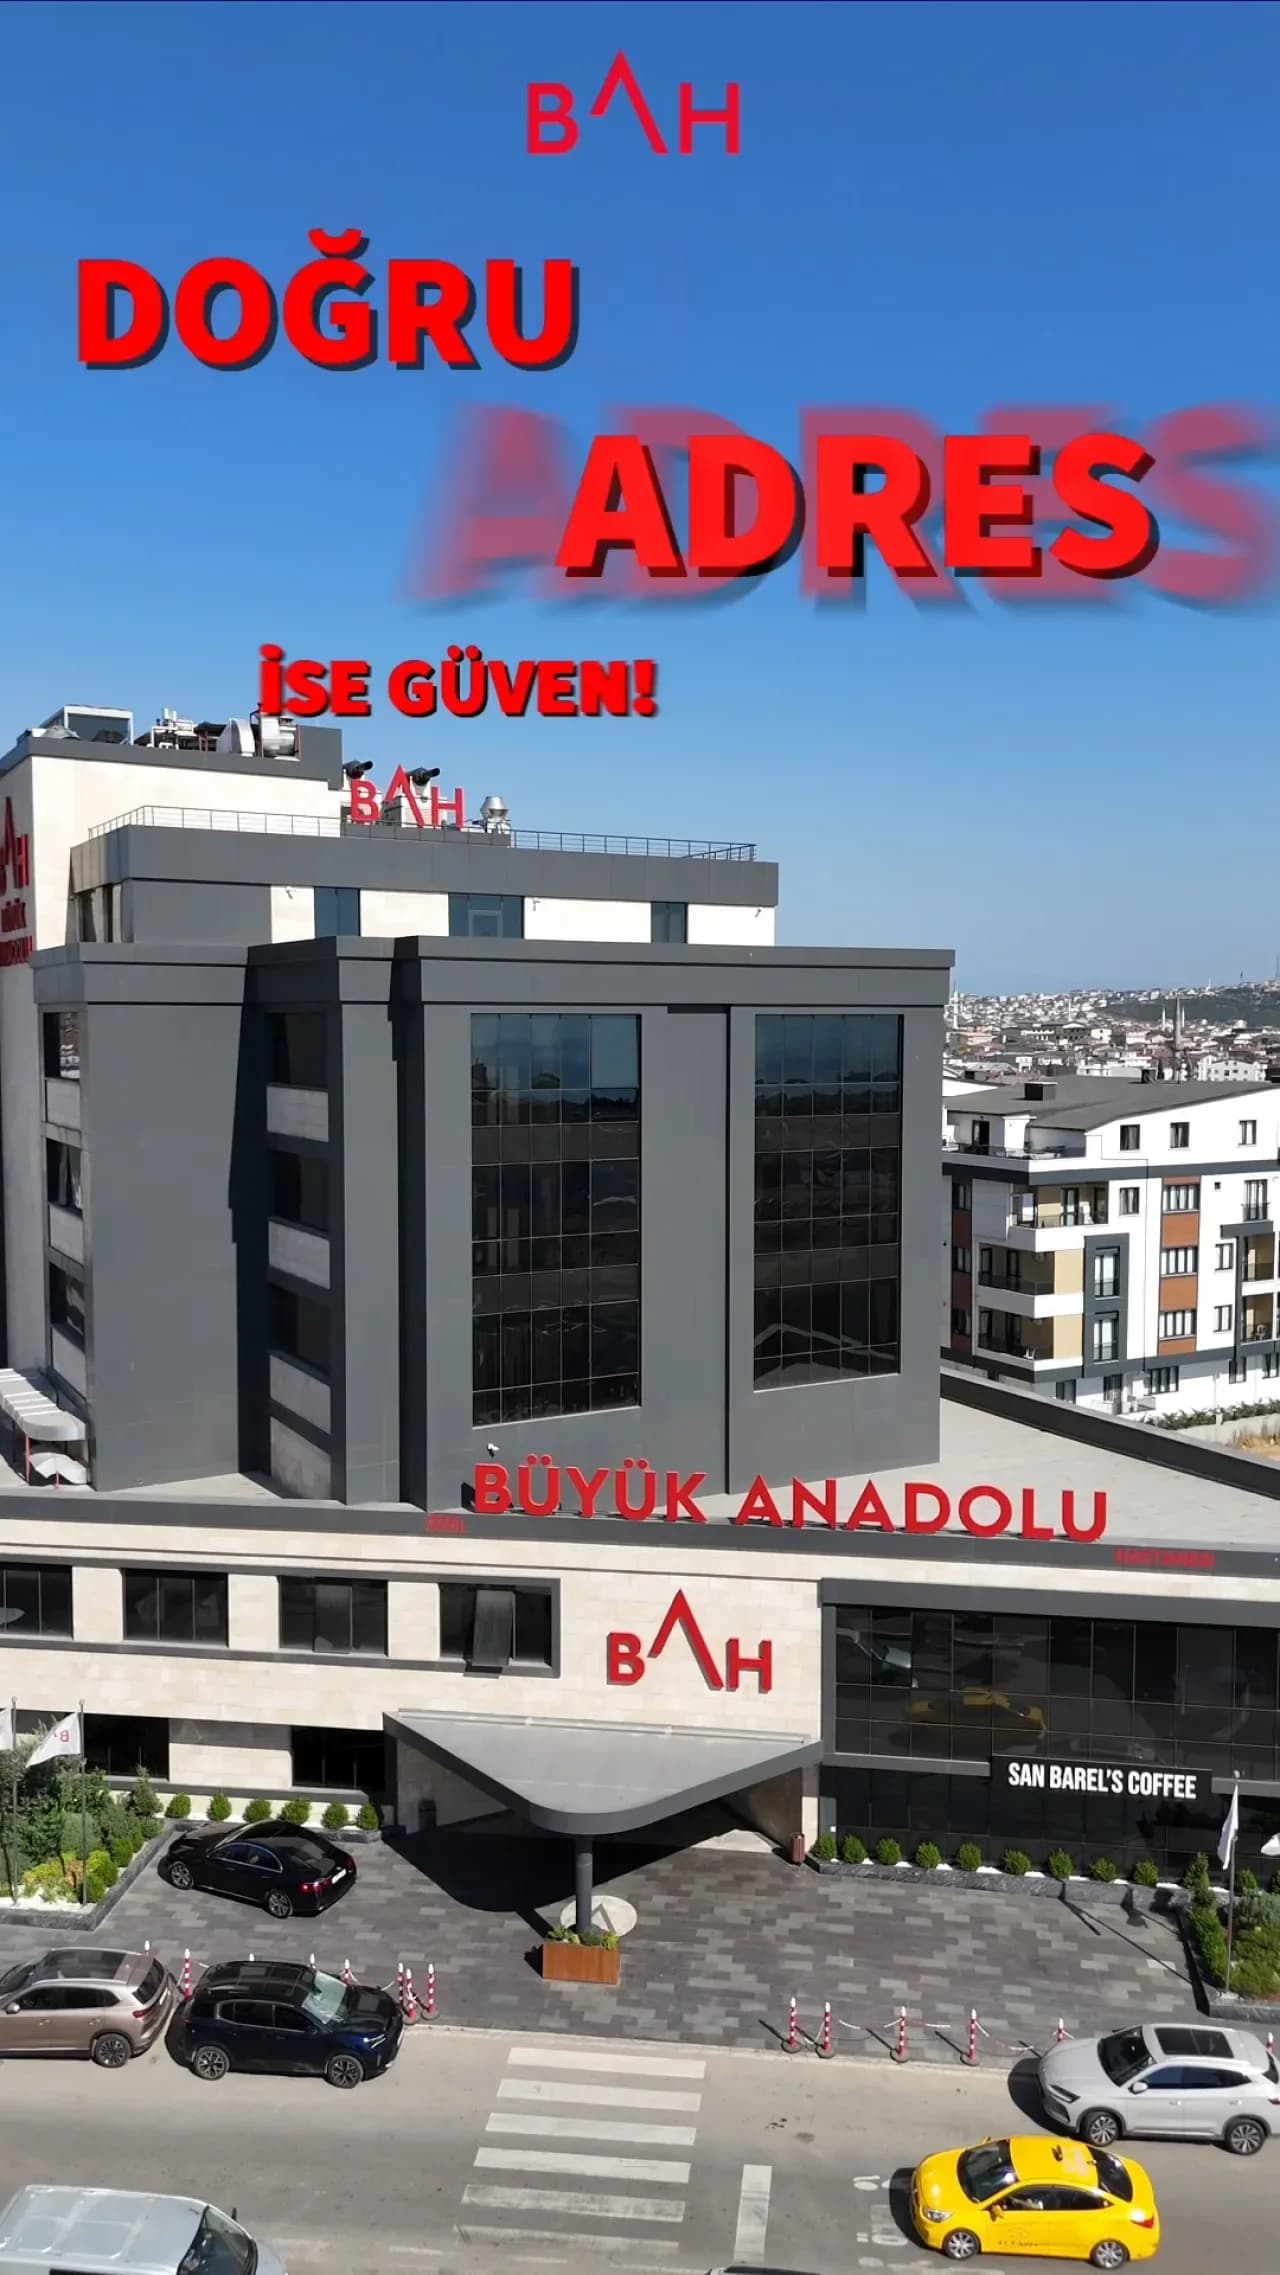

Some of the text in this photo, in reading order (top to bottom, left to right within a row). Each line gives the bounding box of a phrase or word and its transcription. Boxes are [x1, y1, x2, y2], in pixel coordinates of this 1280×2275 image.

[350, 763, 465, 830] BAH
[473, 1453, 1109, 1544] BÜYÜK ANADOLU
[606, 1588, 774, 1694] BAH
[1008, 1761, 1197, 1800] SAN BAREL'S COFFEE
